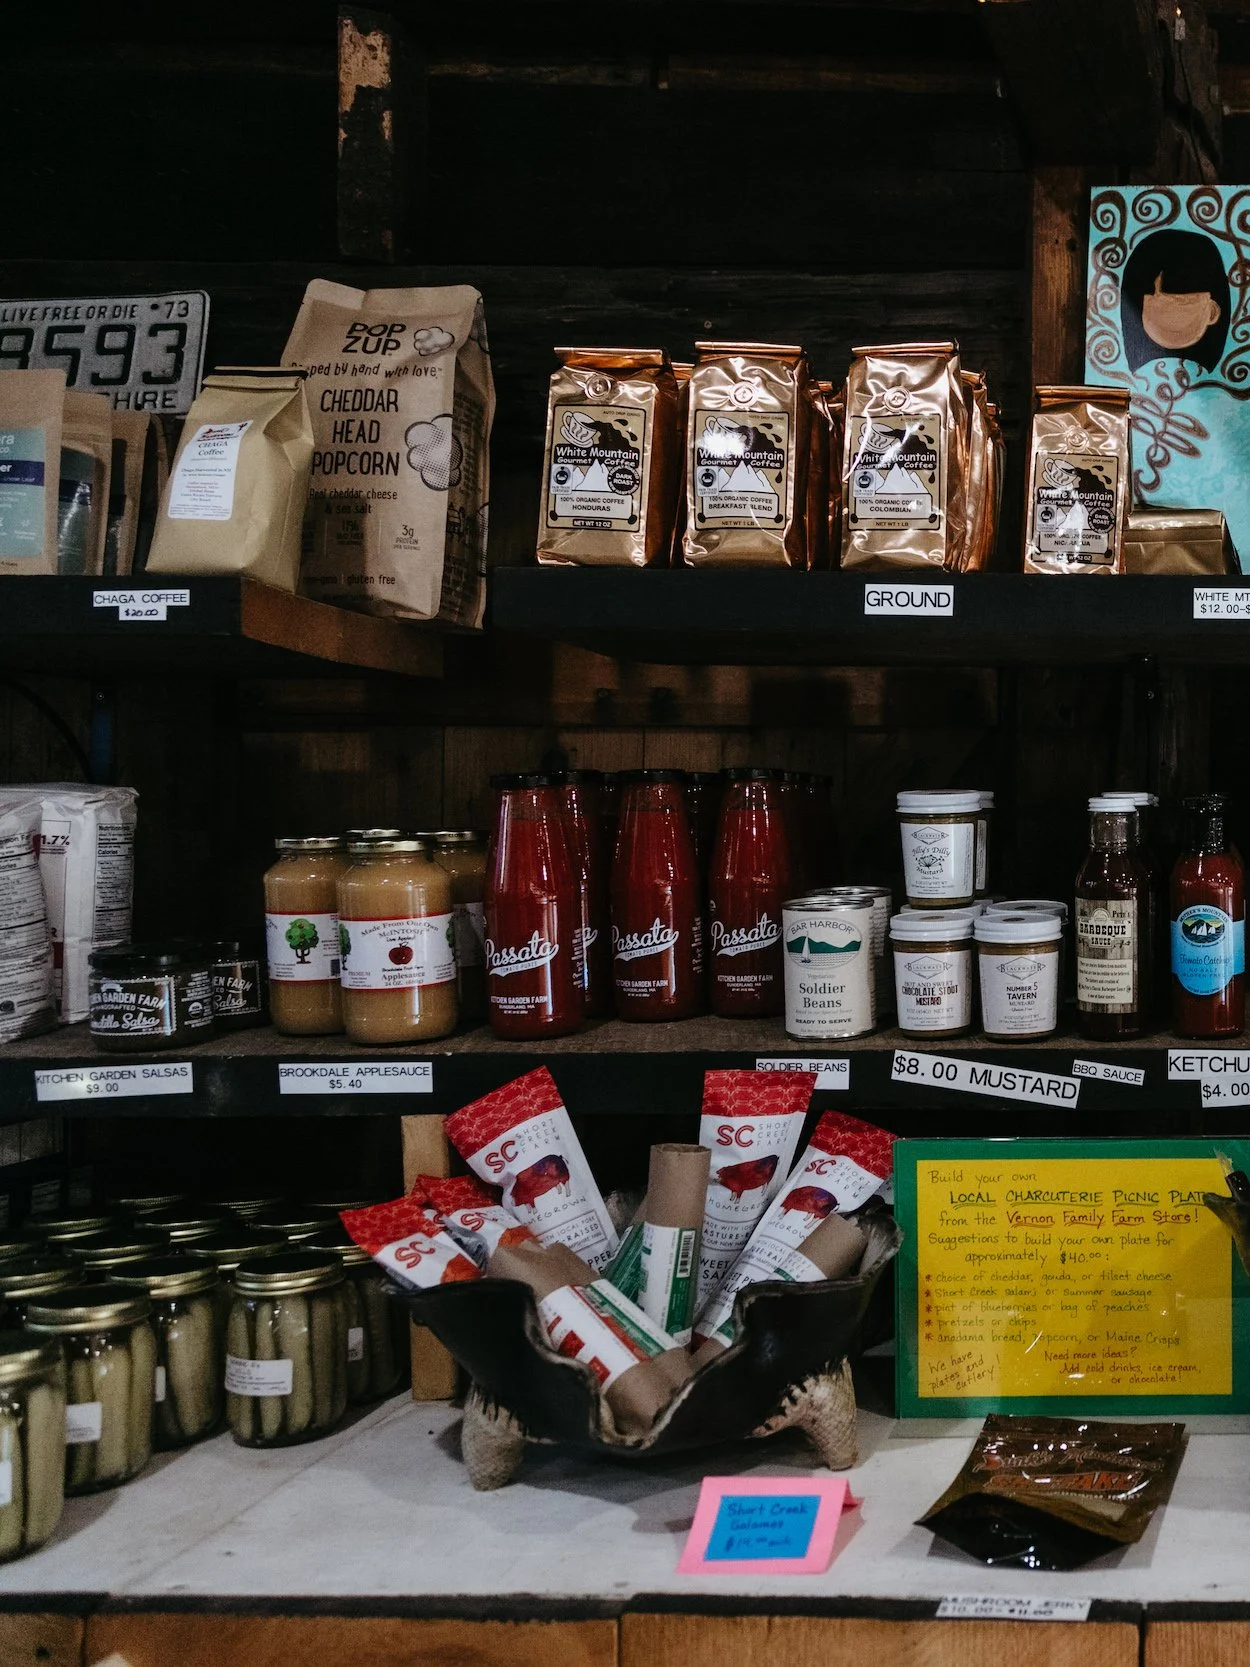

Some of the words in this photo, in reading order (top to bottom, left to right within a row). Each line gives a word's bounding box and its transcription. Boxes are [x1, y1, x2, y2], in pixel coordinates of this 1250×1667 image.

[3, 308, 38, 322] LIVE
[42, 307, 82, 320] FREE
[86, 305, 107, 318] OR
[112, 305, 138, 318] DIE
[164, 301, 189, 318] 73
[348, 323, 406, 337] POP
[342, 336, 400, 355] ZUP
[335, 363, 347, 376] by
[351, 363, 380, 376] hand
[385, 366, 408, 378] with
[321, 389, 399, 412] CHEDDAR
[332, 419, 380, 443] HEAD
[198, 448, 225, 456] Coffee
[557, 447, 587, 457] White
[590, 447, 638, 459] Mountain
[312, 452, 399, 476] POPCORN
[604, 459, 635, 467] Coffee
[613, 478, 633, 486] ROAST
[330, 489, 363, 499] cheddar
[367, 489, 397, 500] cheese
[355, 503, 372, 514] salt
[94, 594, 135, 604] CHAGA
[142, 593, 188, 603] COFFEE
[866, 590, 951, 608] GROUND
[1195, 592, 1229, 602] WHITE
[612, 917, 679, 952] Passata
[711, 912, 783, 952] Passata
[791, 920, 808, 935] BAR
[809, 920, 854, 935] HARBOR
[485, 930, 559, 970] Passata
[1179, 954, 1202, 965] Tomato
[799, 983, 846, 995] Soldier
[902, 985, 936, 997] CHOCOLATE
[1006, 985, 1032, 993] NUMBER
[1033, 982, 1038, 990] 5
[102, 992, 136, 1005] GARDEN
[138, 994, 166, 1010] FARM
[803, 997, 842, 1008] Beans
[1007, 992, 1037, 1001] TAVERN
[122, 1012, 160, 1030] Salsa
[280, 1068, 350, 1077] BROOKDALE
[356, 1066, 430, 1076] APPLESAUCE
[757, 1062, 803, 1073] SOLDIER
[809, 1062, 848, 1073] BEANS
[1073, 1063, 1098, 1077] BBQ
[1102, 1068, 1143, 1083] SAUCE
[36, 1073, 84, 1084] KITCHEN
[89, 1070, 136, 1080] GARDEN
[142, 1067, 188, 1077] SALSAS
[893, 1055, 958, 1082] $8.00
[969, 1067, 1078, 1100] MUSTARD
[86, 1083, 119, 1094] $9.00
[329, 1079, 362, 1089] $5.40
[1202, 1082, 1250, 1099] $4.00
[716, 1125, 755, 1147] SC
[485, 1140, 518, 1173] SC
[805, 1159, 836, 1175] SC
[929, 1170, 963, 1184] Build
[975, 1174, 1003, 1192] your
[1011, 1173, 1037, 1183] own
[950, 1191, 996, 1205] LOCAL
[1006, 1190, 1104, 1203] CHARCUTERIE
[1113, 1190, 1160, 1203] PICNIC
[1168, 1190, 1204, 1203] PLAT
[939, 1211, 970, 1226] from
[974, 1212, 996, 1225] the
[1006, 1210, 1055, 1225] Vernon
[1063, 1210, 1105, 1229] Family
[1112, 1212, 1145, 1224] Farm
[1153, 1210, 1198, 1224] Store!
[929, 1233, 999, 1251] Suggestions
[1004, 1234, 1018, 1245] to
[1025, 1232, 1052, 1244] build
[1058, 1236, 1086, 1251] your
[965, 1250, 1047, 1269] approximately
